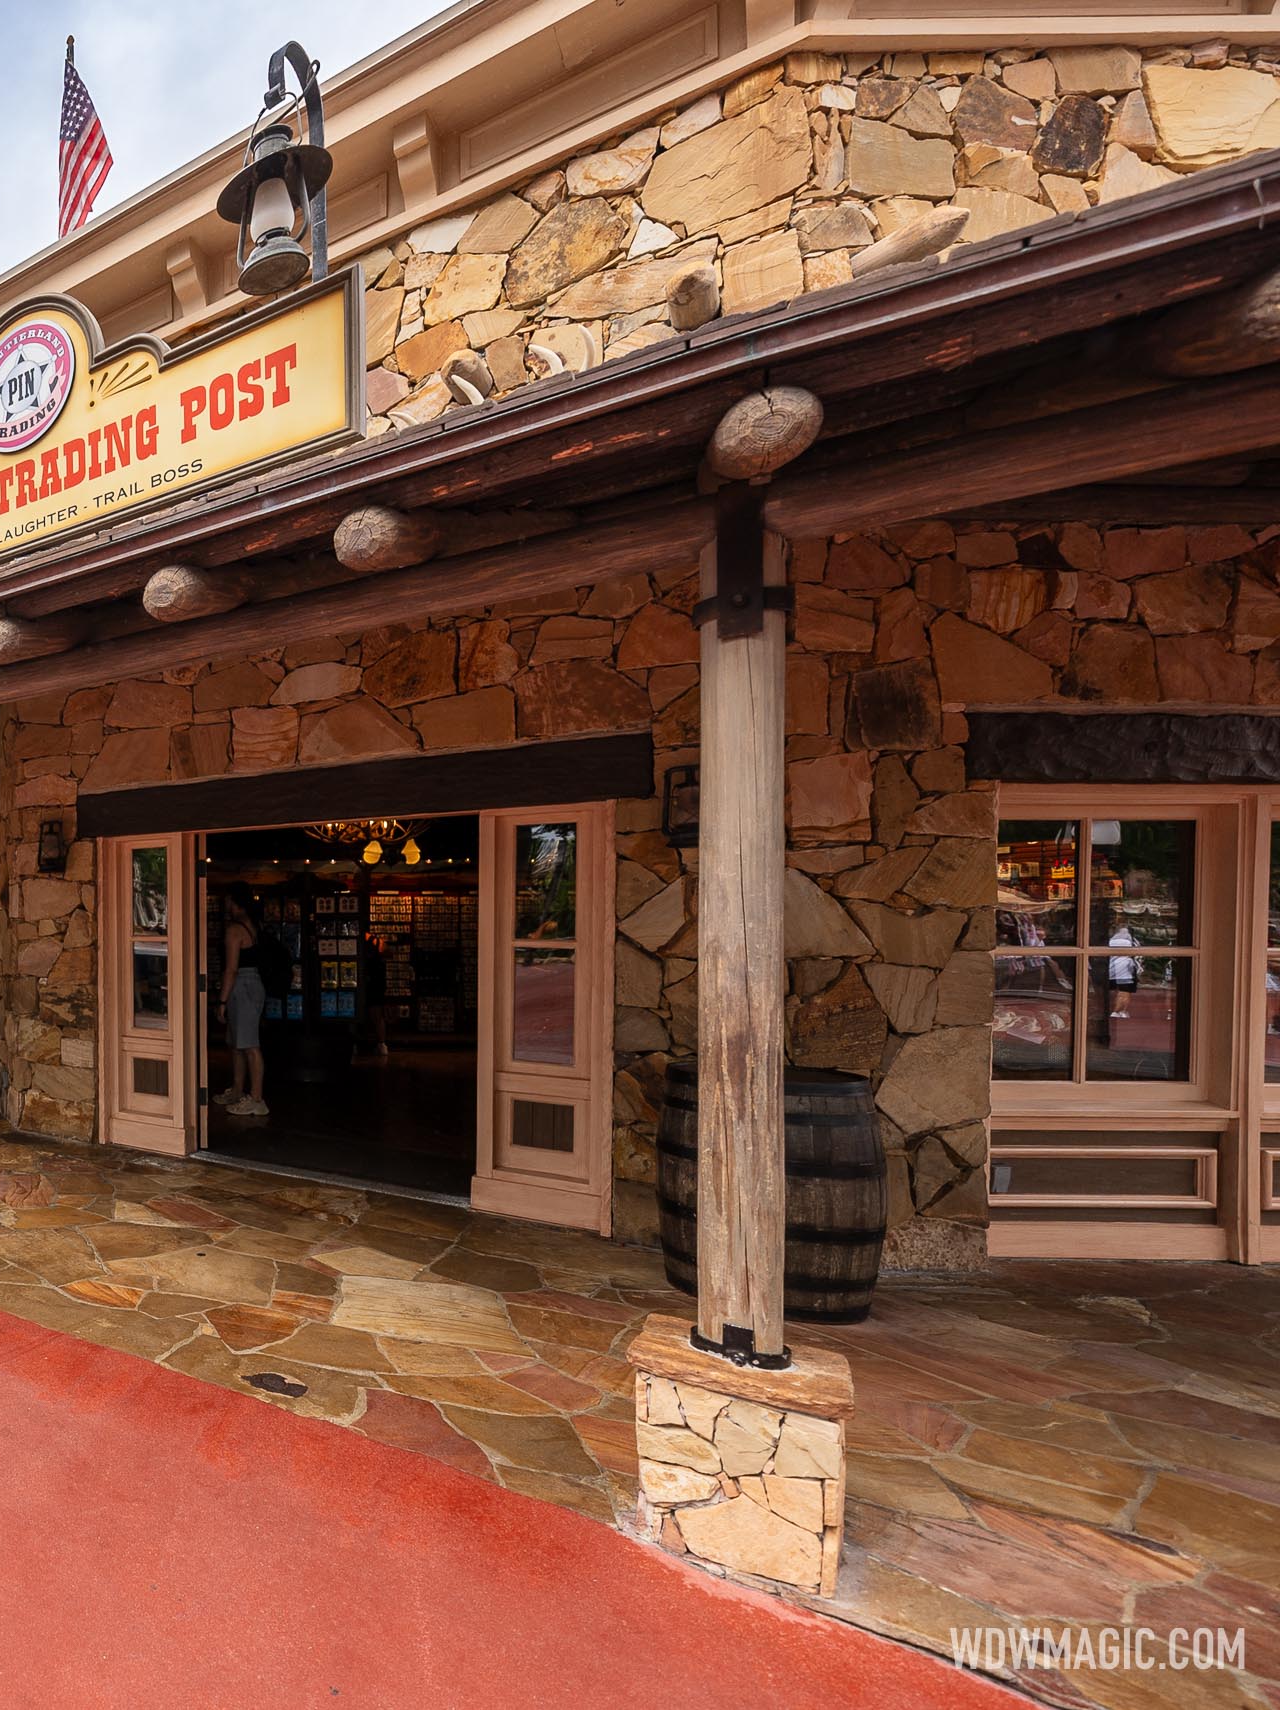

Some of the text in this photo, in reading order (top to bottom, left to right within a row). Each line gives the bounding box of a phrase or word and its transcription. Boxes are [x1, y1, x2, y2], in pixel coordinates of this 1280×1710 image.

[7, 367, 35, 406] PIN
[180, 342, 297, 445] POST
[93, 482, 144, 508] TRAIL
[150, 458, 204, 489] BOSS
